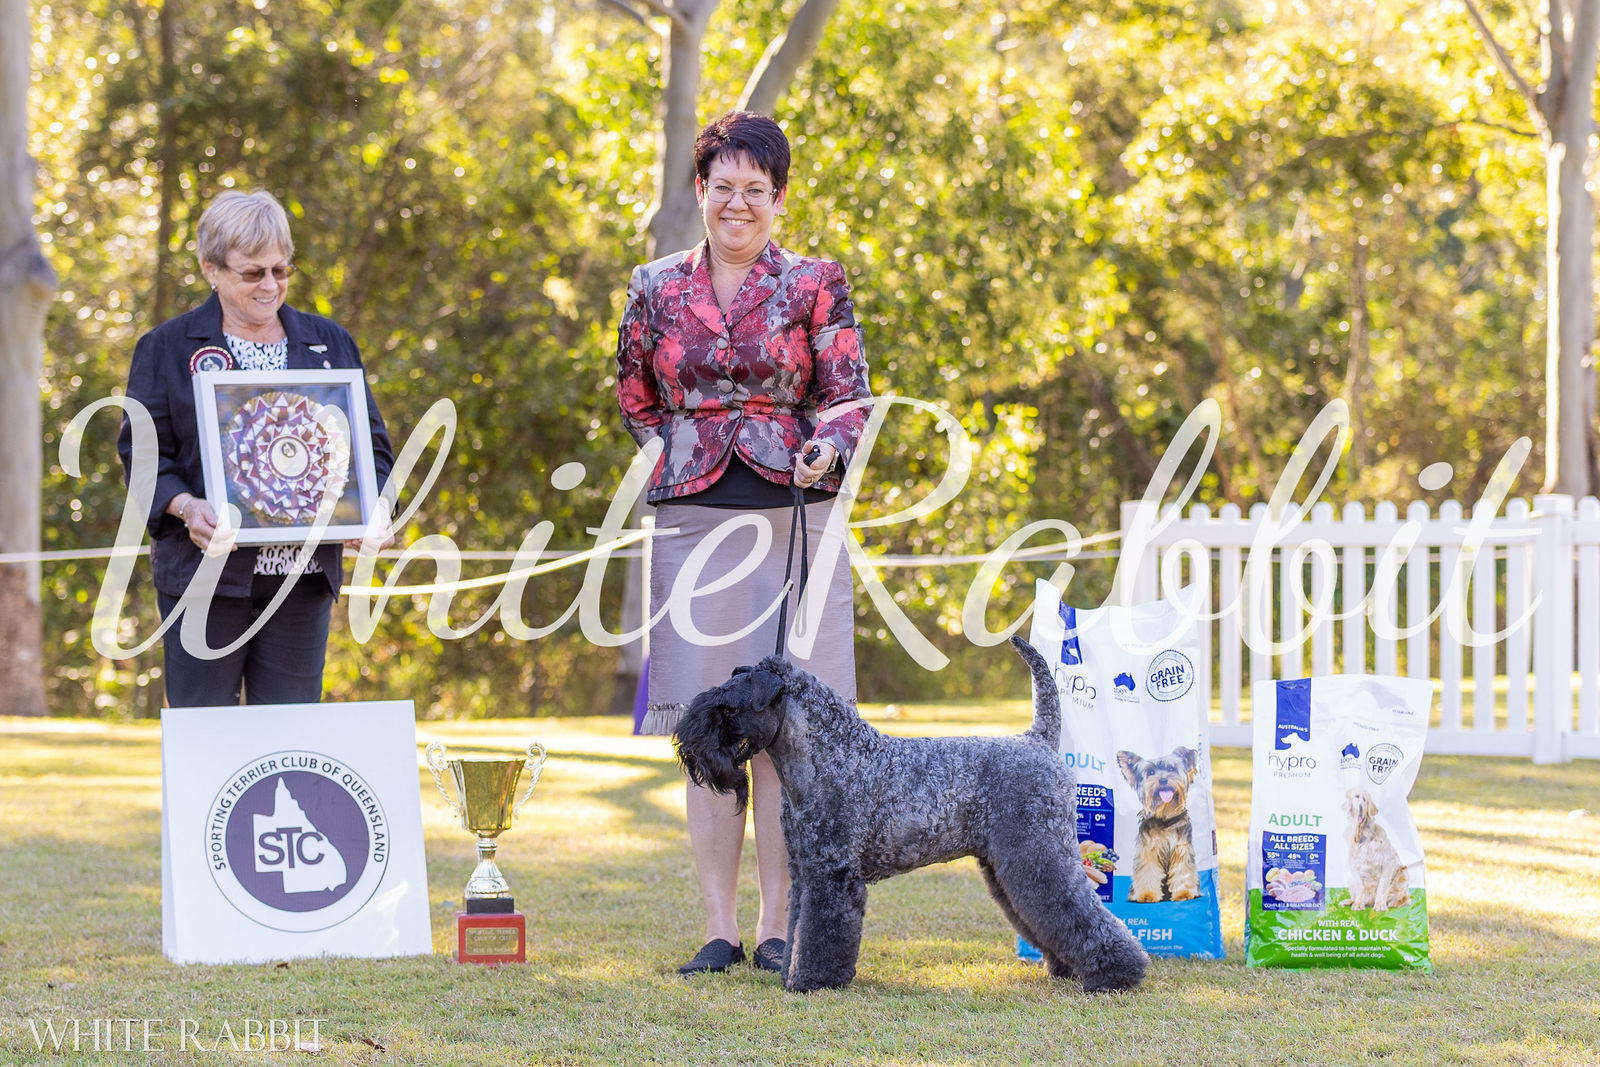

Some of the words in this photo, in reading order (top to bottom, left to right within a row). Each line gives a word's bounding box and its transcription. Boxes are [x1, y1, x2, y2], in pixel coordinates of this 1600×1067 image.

[1150, 664, 1185, 683] GRAIN
[1156, 674, 1185, 691] FREE
[1065, 752, 1106, 774] DULT
[1268, 751, 1317, 771] hypro
[1368, 756, 1399, 766] GRAIN
[1273, 770, 1312, 779] PREMIUM
[1077, 786, 1107, 798] REEDS
[211, 798, 232, 870] SPORTING
[226, 759, 278, 798] TERRIER
[281, 756, 318, 770] CLUB
[321, 762, 342, 777] OF
[342, 773, 386, 863] QUEENSLAND
[1094, 813, 1106, 821] 0%
[1268, 813, 1323, 827] ADULT
[1269, 834, 1285, 843] ALL
[1286, 835, 1320, 843] BREEDS
[258, 826, 325, 869] STC
[1273, 842, 1290, 850] ALL
[1291, 843, 1315, 851] SIZES
[1127, 917, 1149, 926] REAL
[1318, 920, 1338, 928] WITH
[1340, 920, 1360, 928] REAL
[1137, 928, 1173, 941] FISH
[1278, 929, 1342, 941] CHICKEN
[1345, 930, 1356, 941] &
[1359, 929, 1399, 941] DUCK
